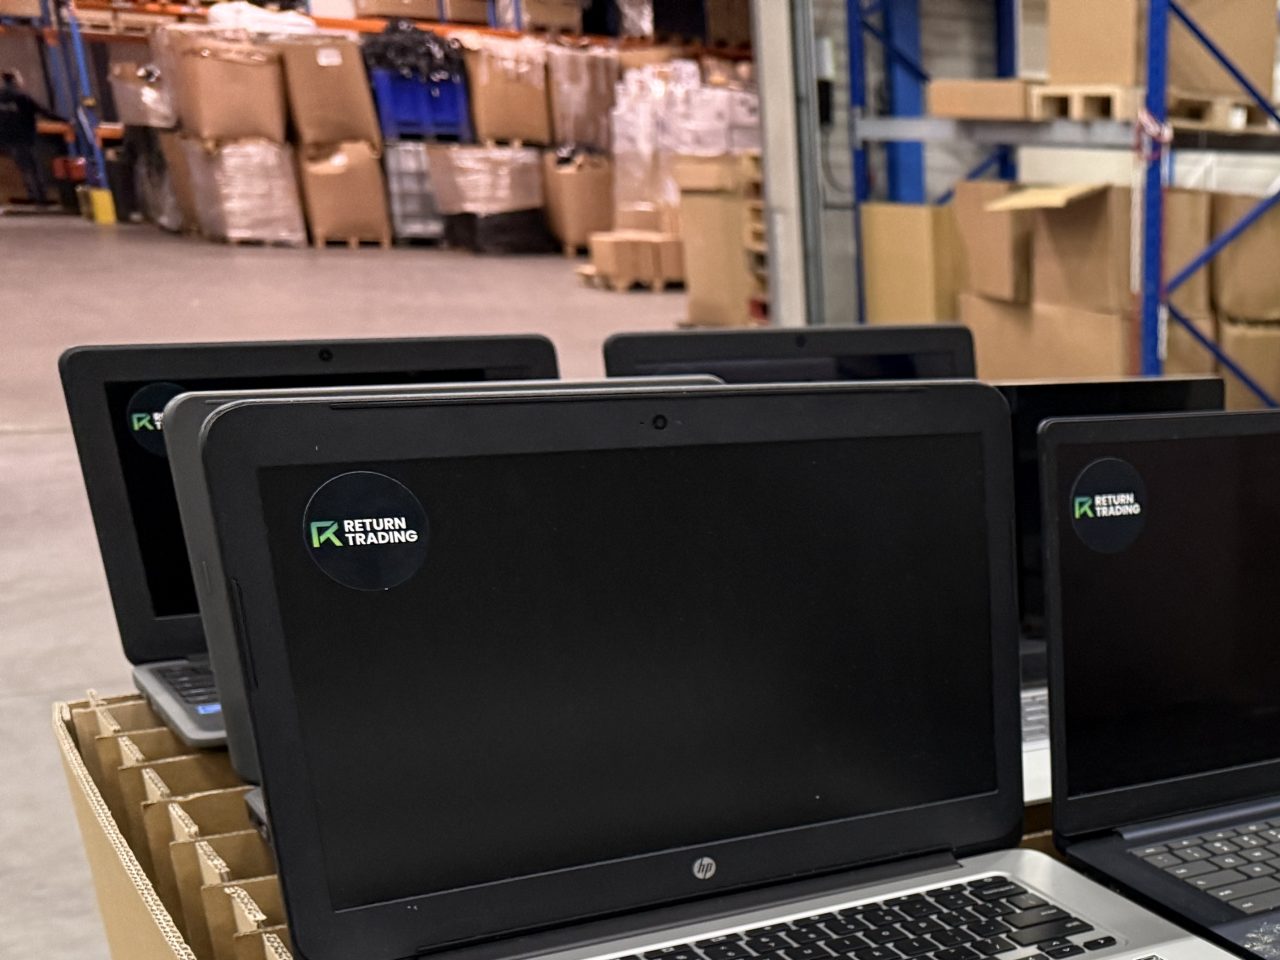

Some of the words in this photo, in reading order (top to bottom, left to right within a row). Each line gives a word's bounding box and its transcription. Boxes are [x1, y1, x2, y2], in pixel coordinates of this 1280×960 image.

[1094, 492, 1135, 506] RETURN
[1095, 502, 1141, 518] TRADING
[343, 517, 407, 532] RETURN
[345, 530, 418, 546] TRADING
